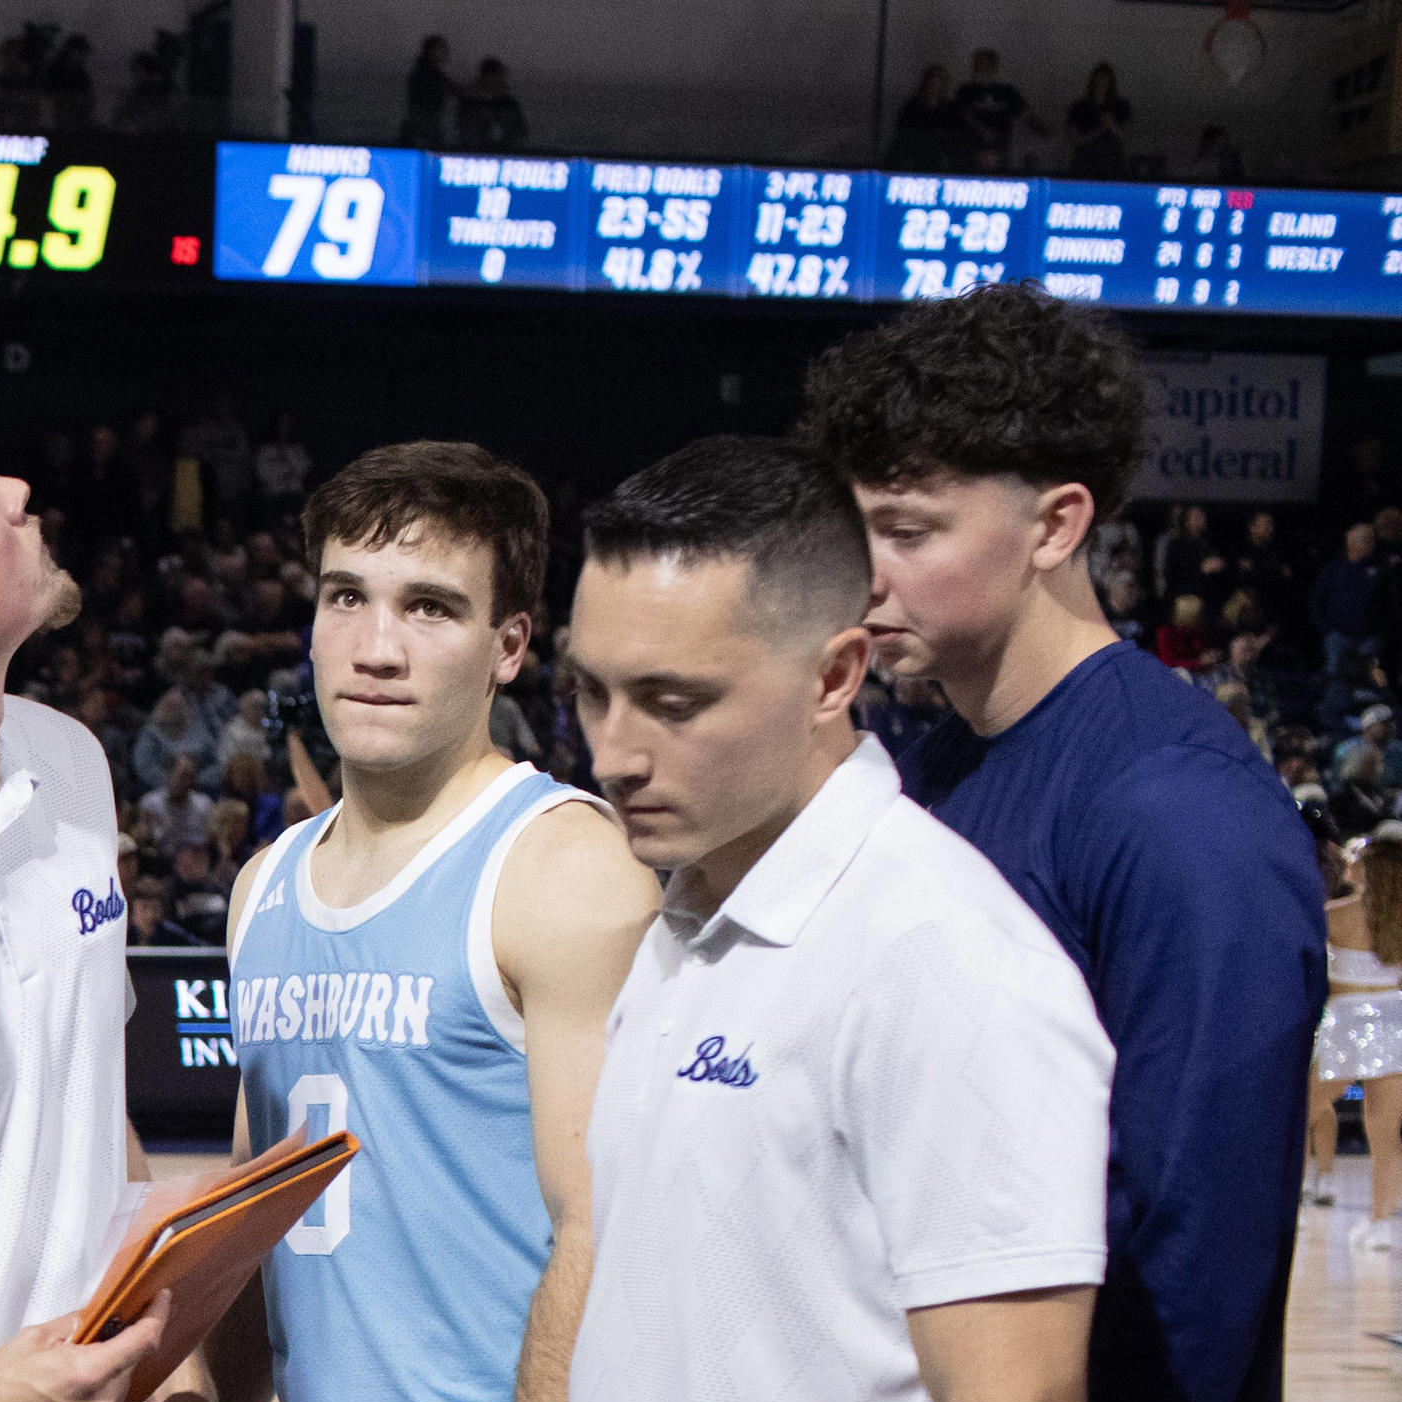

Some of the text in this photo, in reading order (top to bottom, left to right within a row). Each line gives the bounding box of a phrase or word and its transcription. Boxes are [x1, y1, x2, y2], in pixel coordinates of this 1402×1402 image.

[285, 143, 372, 177] HAWKS
[262, 173, 385, 279] 79
[598, 196, 711, 241] 23-55
[756, 202, 847, 246] 11-23
[900, 208, 1011, 252] 22-28
[1269, 212, 1337, 238] EILAND
[603, 247, 702, 290] 41.8%
[747, 253, 849, 296] 47.8%
[1267, 246, 1343, 271] WESLEY
[72, 877, 124, 935] Bods
[237, 973, 433, 1046] WASHBURN
[677, 1035, 758, 1087] Bods
